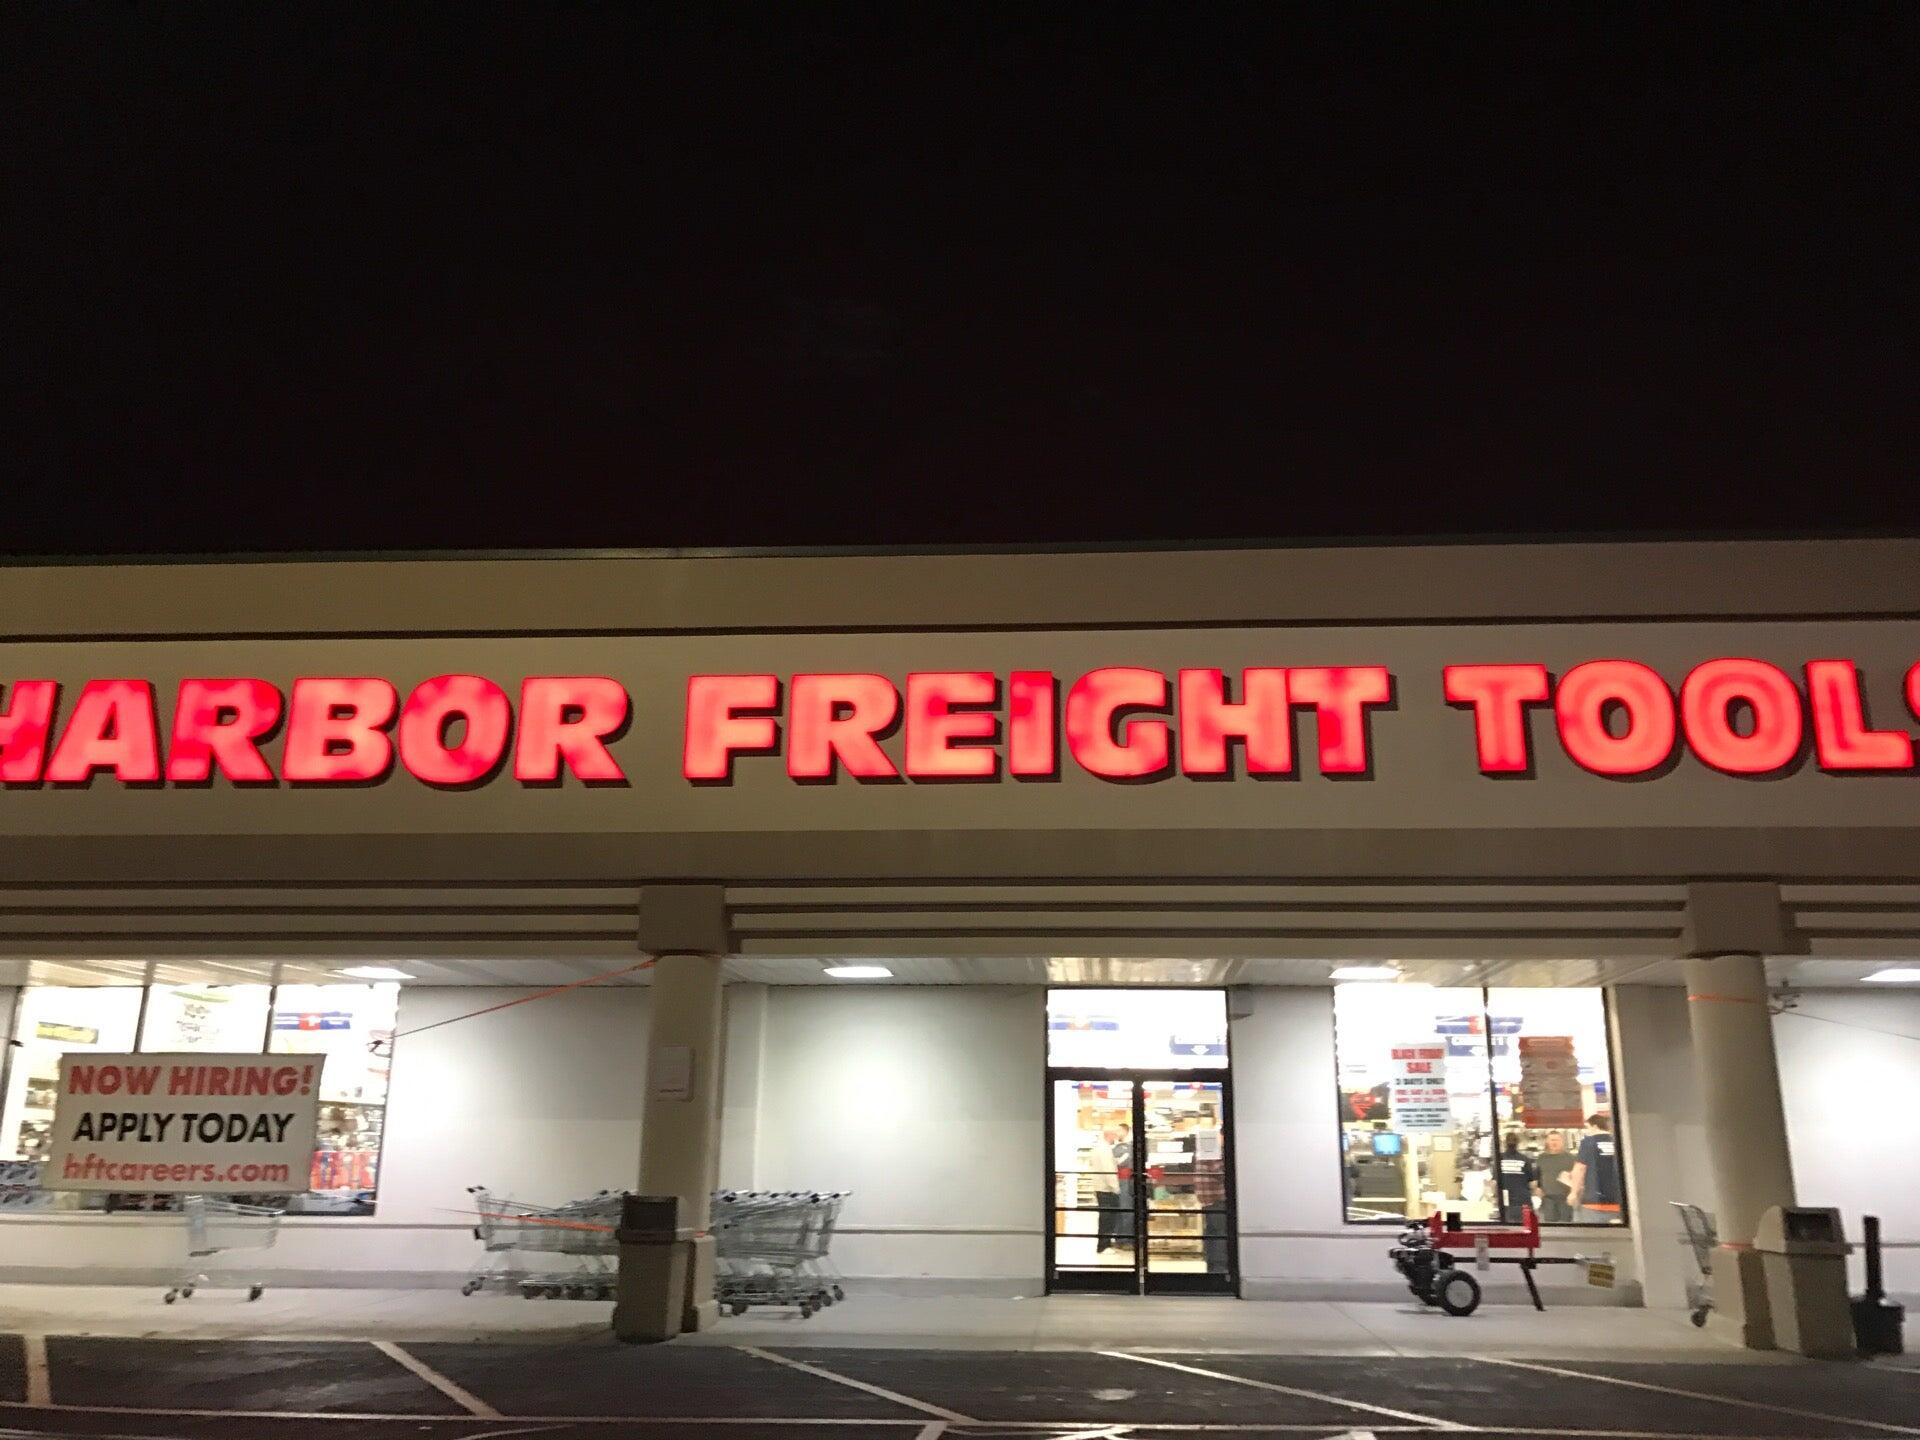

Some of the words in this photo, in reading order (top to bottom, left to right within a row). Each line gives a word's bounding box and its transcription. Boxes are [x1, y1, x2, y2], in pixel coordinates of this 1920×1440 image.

[683, 666, 1390, 779] FREIGHT
[1443, 658, 1920, 774] TOOL
[69, 1065, 161, 1096] NOW
[168, 1065, 315, 1096] HIRING!
[72, 1112, 175, 1143] APPLY
[182, 1112, 295, 1144] TODAY
[63, 1152, 289, 1183] hftcareers.com
